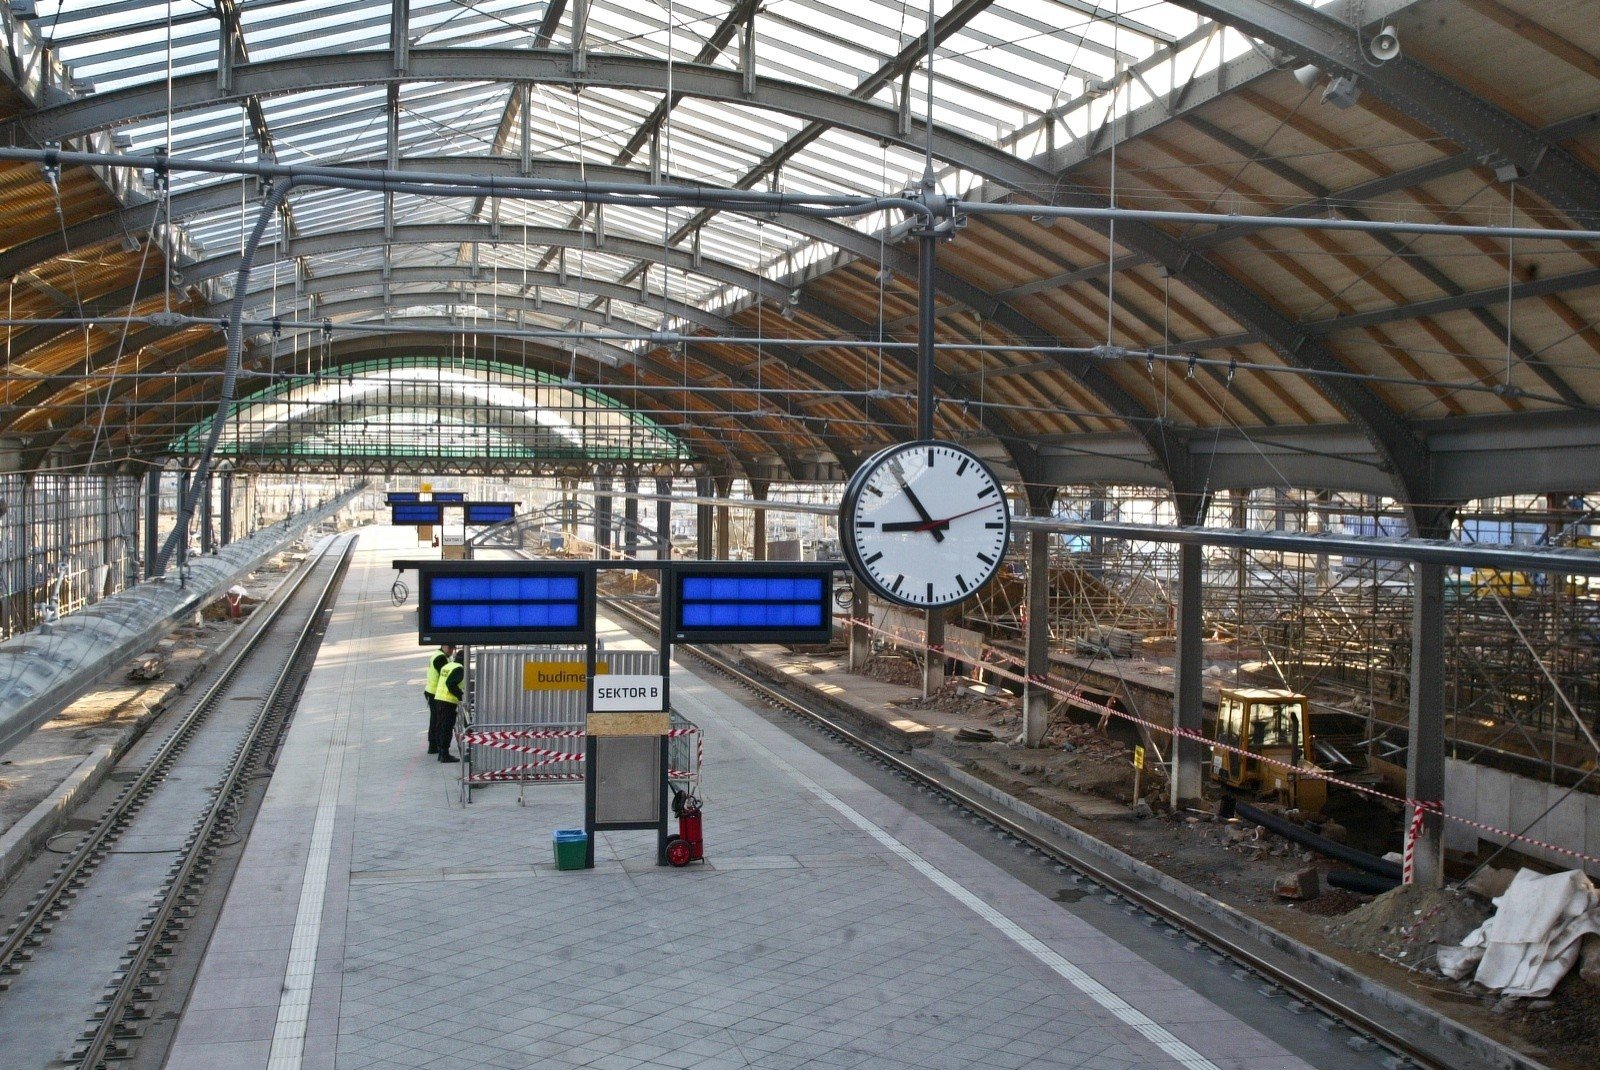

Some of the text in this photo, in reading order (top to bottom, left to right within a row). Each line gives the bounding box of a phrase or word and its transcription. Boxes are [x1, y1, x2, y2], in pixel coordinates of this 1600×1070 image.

[537, 670, 587, 683] budime
[598, 687, 658, 699] SEKTOR B
